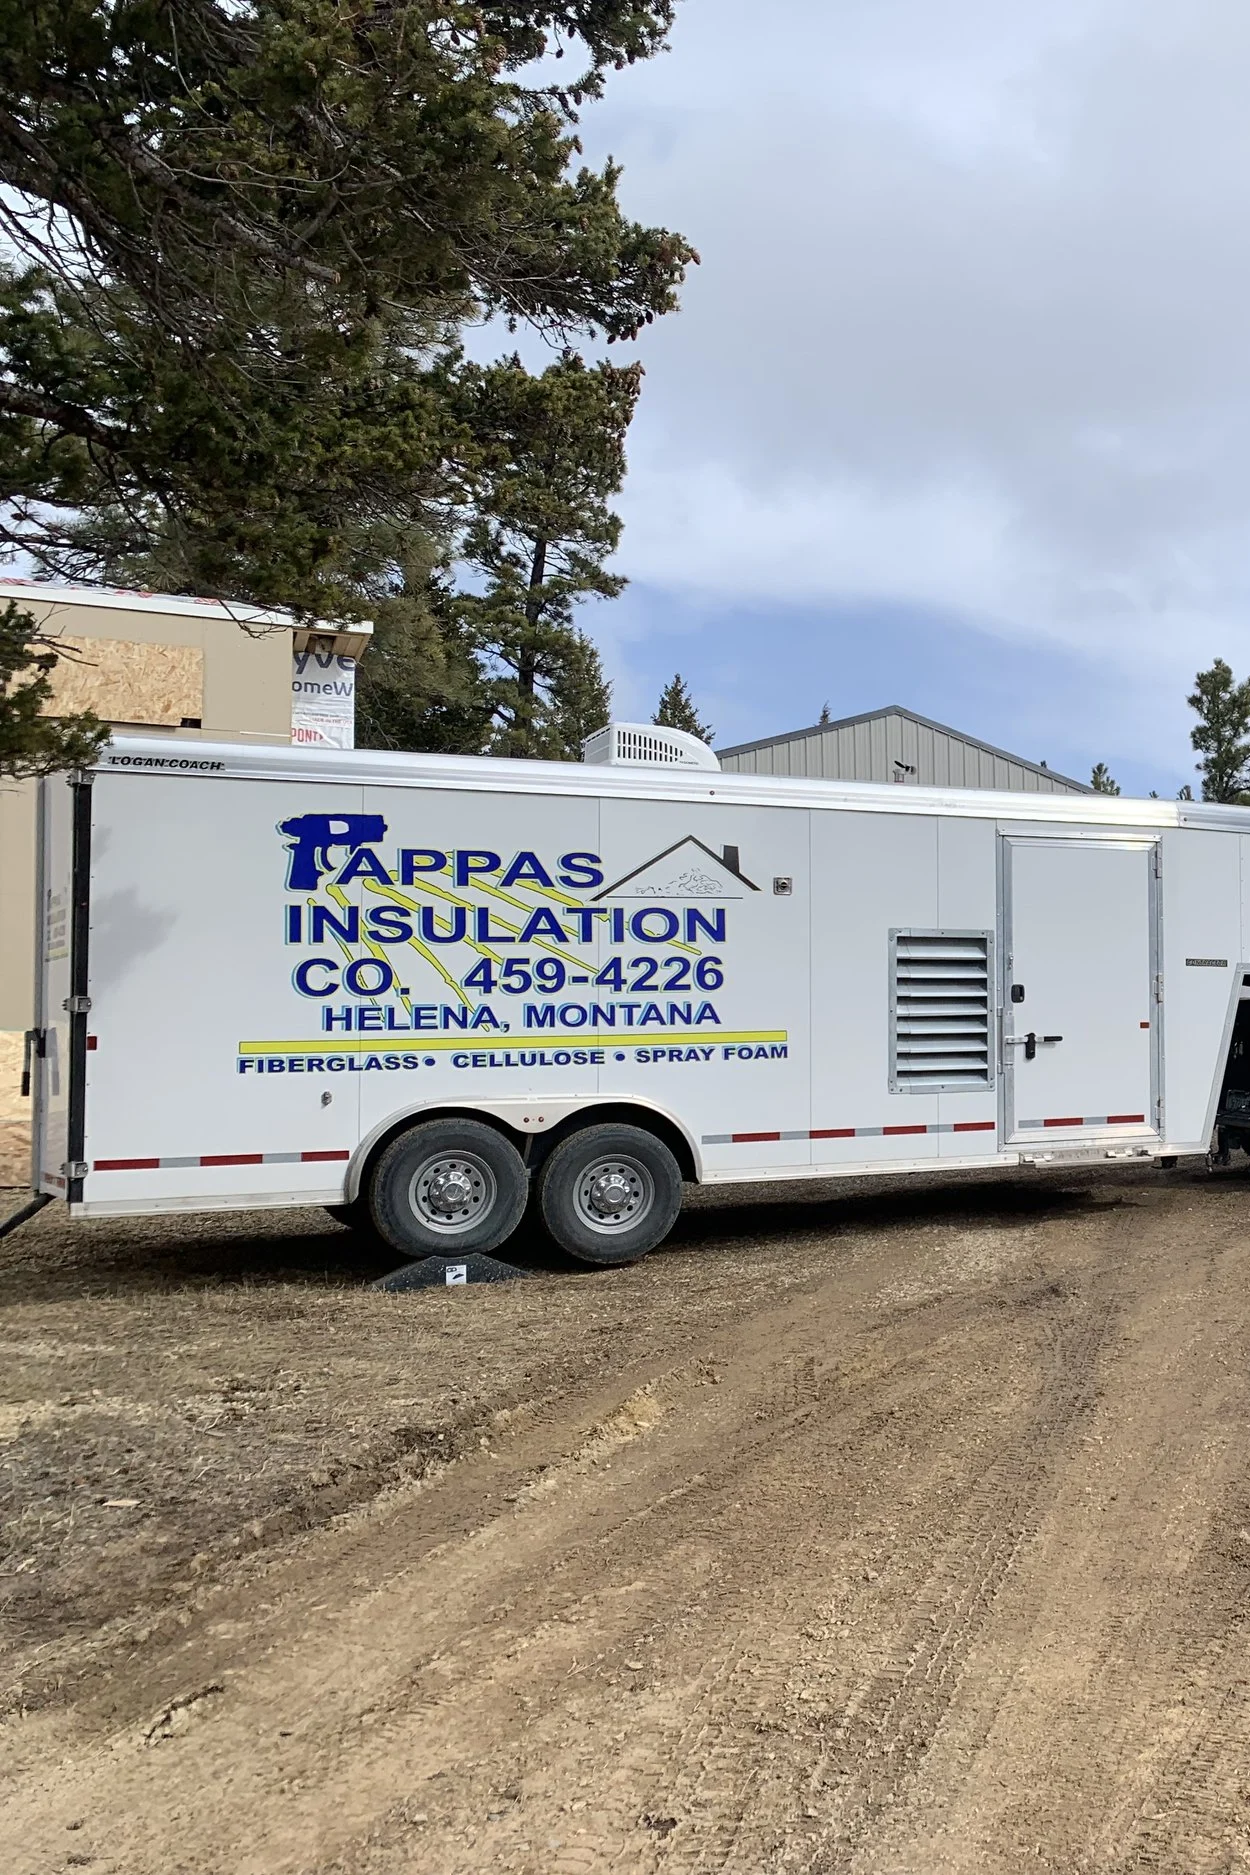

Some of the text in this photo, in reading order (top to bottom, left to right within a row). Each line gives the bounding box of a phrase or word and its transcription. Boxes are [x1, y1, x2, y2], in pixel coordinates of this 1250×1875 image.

[292, 681, 353, 696] omeW
[110, 756, 222, 770] LOGAN COACH
[277, 813, 604, 891] PAPPAS
[286, 905, 726, 945] INSULATION
[294, 955, 725, 998] CO. 459-4226
[322, 1001, 721, 1032] HELENA, MONTANA
[237, 1044, 788, 1074] FIBERGLASS CELLULOSE SPRAY FOAM
